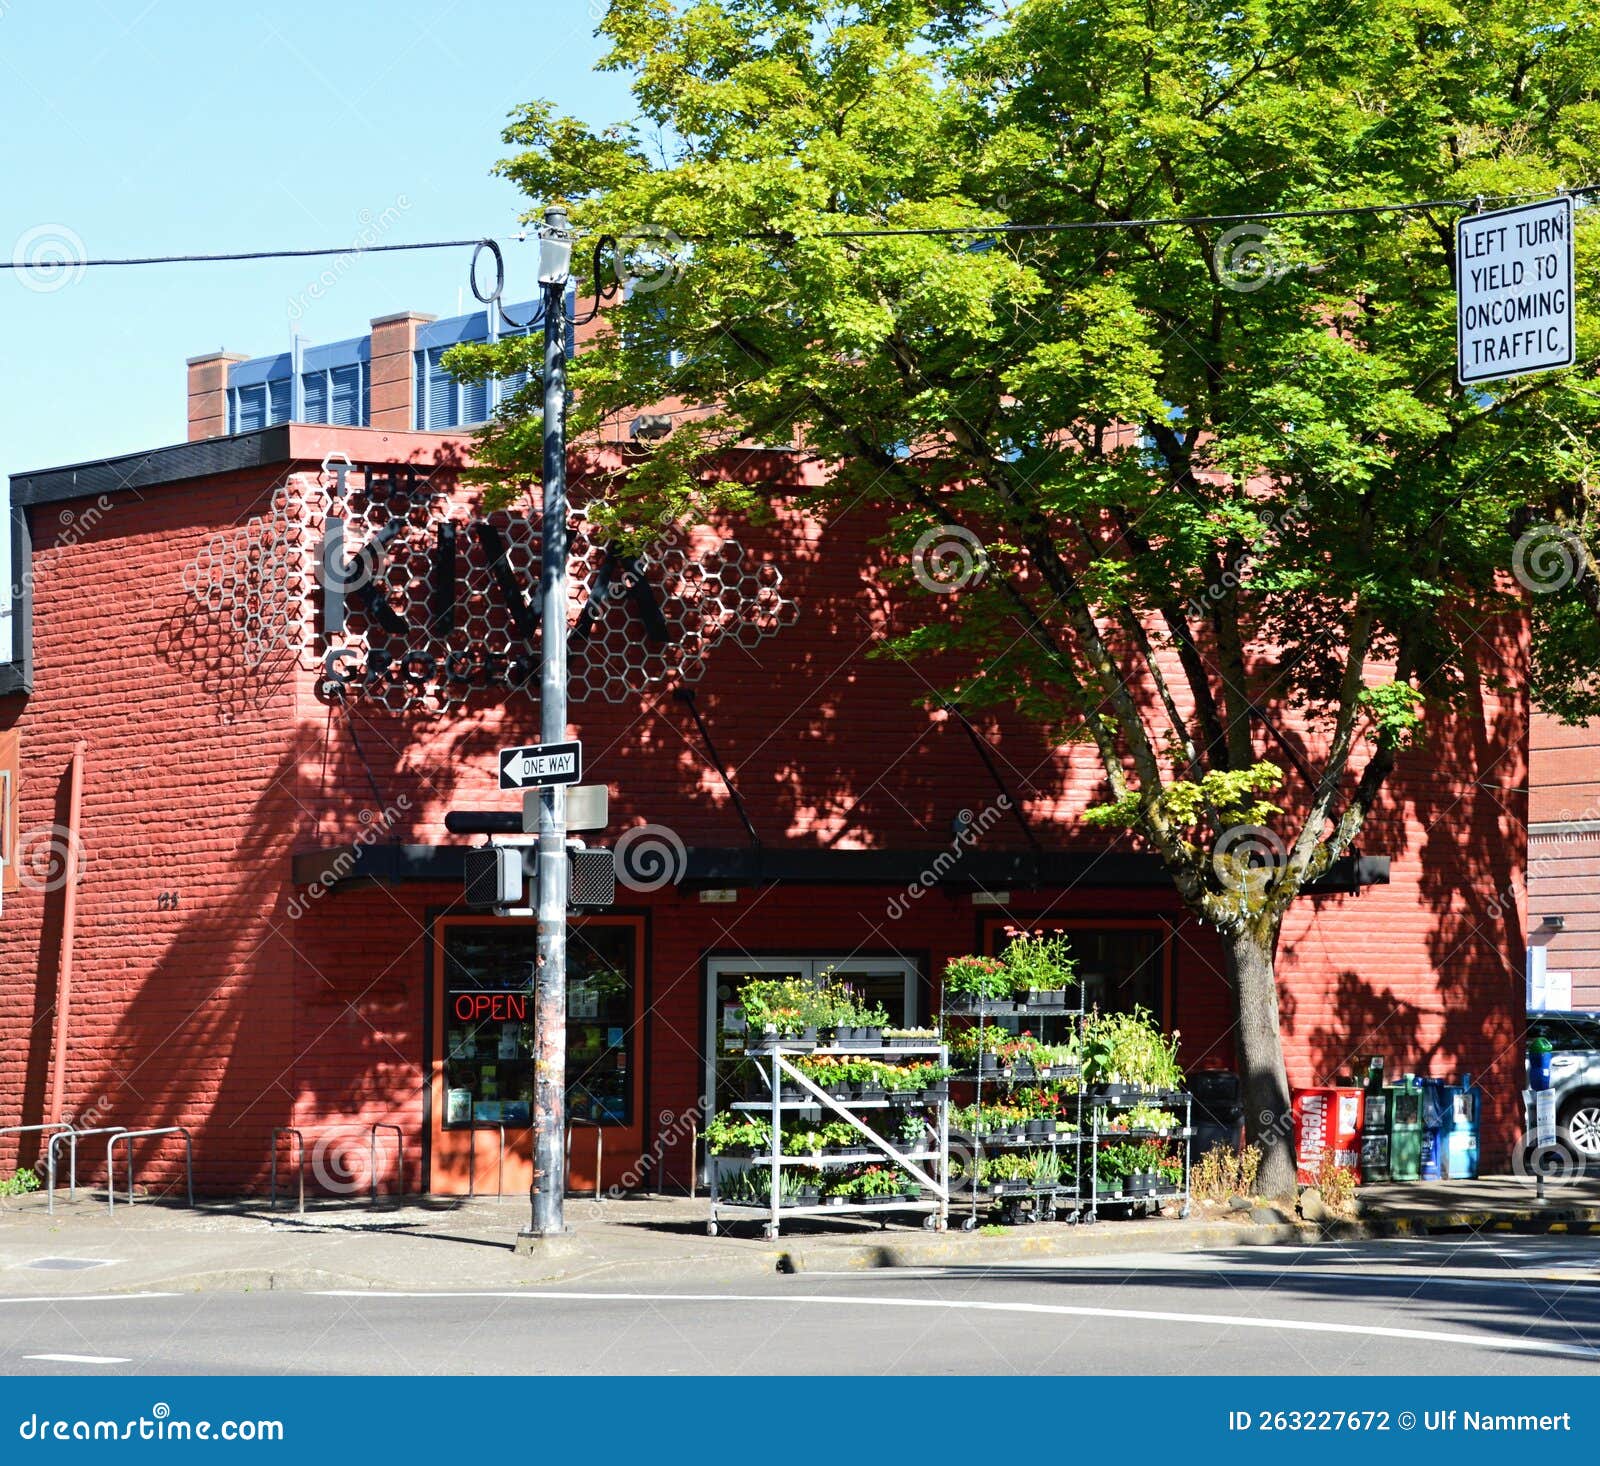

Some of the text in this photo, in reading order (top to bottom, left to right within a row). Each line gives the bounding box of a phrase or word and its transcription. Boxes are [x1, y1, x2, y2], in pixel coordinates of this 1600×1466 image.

[1465, 215, 1563, 259] LEFT TURN
[1471, 261, 1524, 293] YIELD
[1535, 254, 1558, 281] TO
[1466, 289, 1565, 330] ONCOMING
[1472, 327, 1558, 364] TRAFFIC
[325, 517, 670, 643] KIVA
[524, 755, 571, 775] ONE WAY
[455, 994, 526, 1020] OPEN
